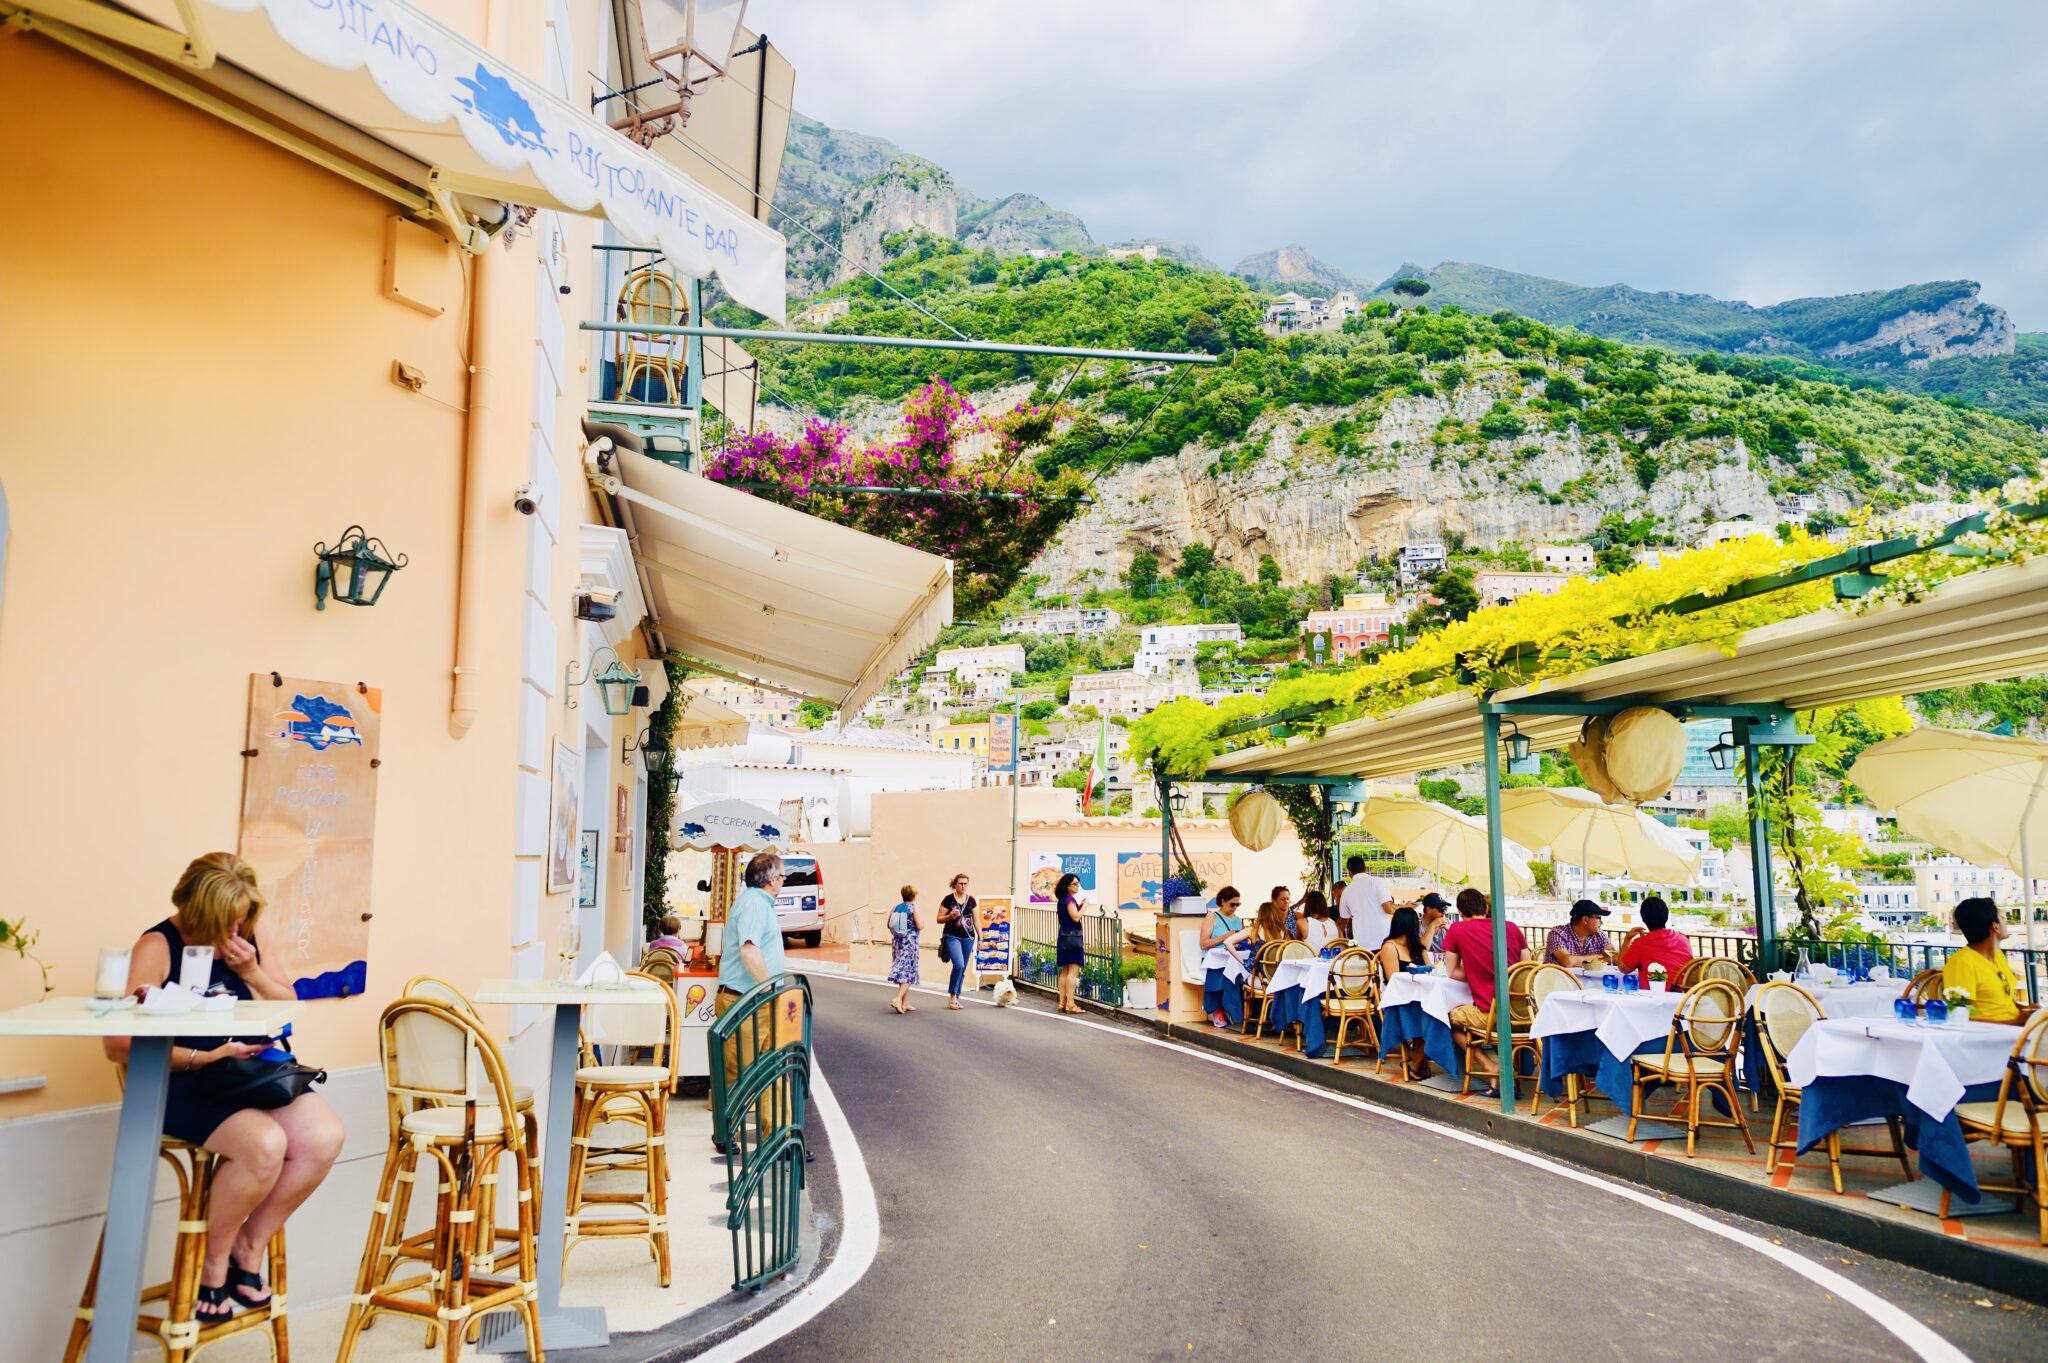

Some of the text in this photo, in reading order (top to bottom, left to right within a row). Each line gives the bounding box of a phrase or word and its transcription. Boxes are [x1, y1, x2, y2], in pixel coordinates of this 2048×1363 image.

[569, 131, 739, 265] RISTORANTE BAR
[703, 814, 757, 829] ICE CREAM
[1065, 856, 1091, 867] PIZZA
